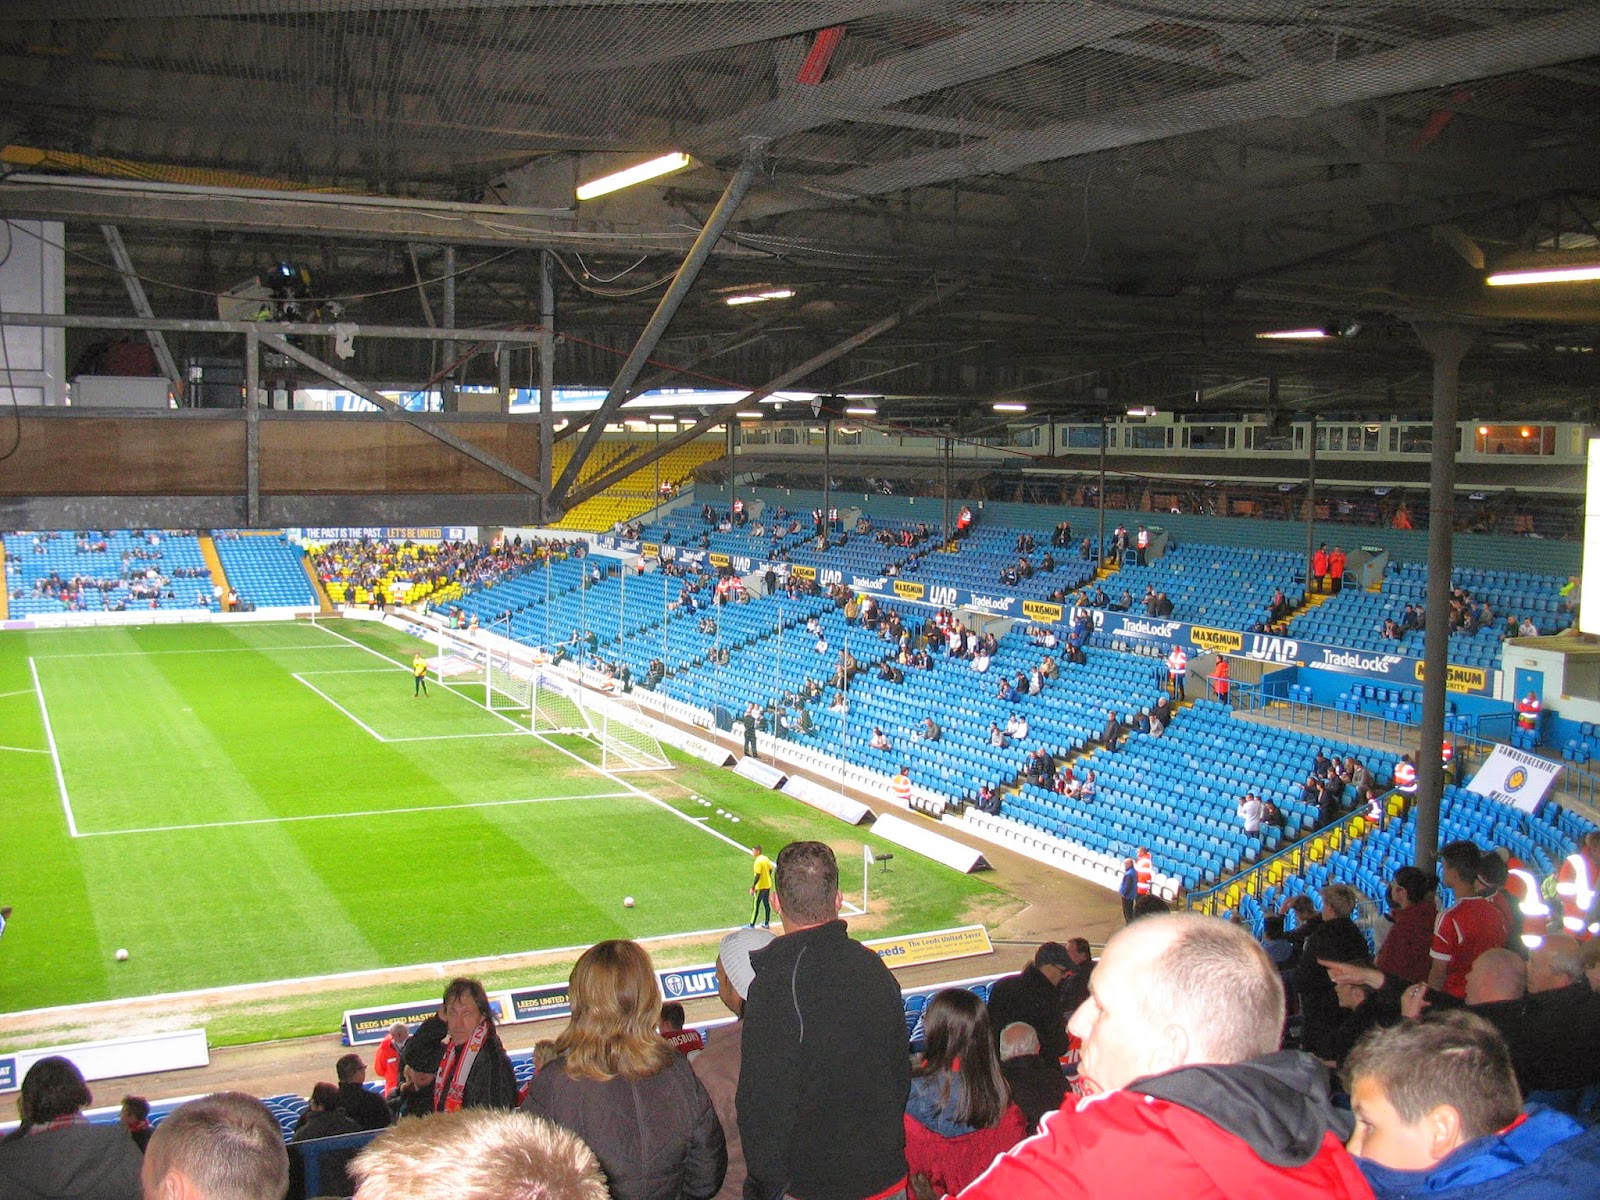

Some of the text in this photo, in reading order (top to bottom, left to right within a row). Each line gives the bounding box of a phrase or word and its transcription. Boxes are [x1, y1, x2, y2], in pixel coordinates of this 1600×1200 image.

[307, 528, 320, 538] THE
[321, 528, 339, 538] PAST
[340, 528, 348, 538] IS
[348, 528, 363, 538] THE
[387, 528, 407, 538] LET'S
[407, 528, 417, 538] BE
[417, 528, 441, 538] UNITED
[970, 593, 1009, 611] TradeLocks
[1122, 617, 1172, 638] TradeLocks
[1322, 649, 1390, 673] TradeLocks
[1498, 745, 1557, 773] CAMBRIDGESHIRE
[1488, 790, 1517, 806] WHITES
[941, 933, 964, 943] United
[877, 945, 906, 957] eeds
[684, 971, 719, 993] LUT
[516, 995, 565, 1008] LEEDS UNITED
[355, 1020, 380, 1030] LEEDS
[380, 1016, 407, 1027] UNITED
